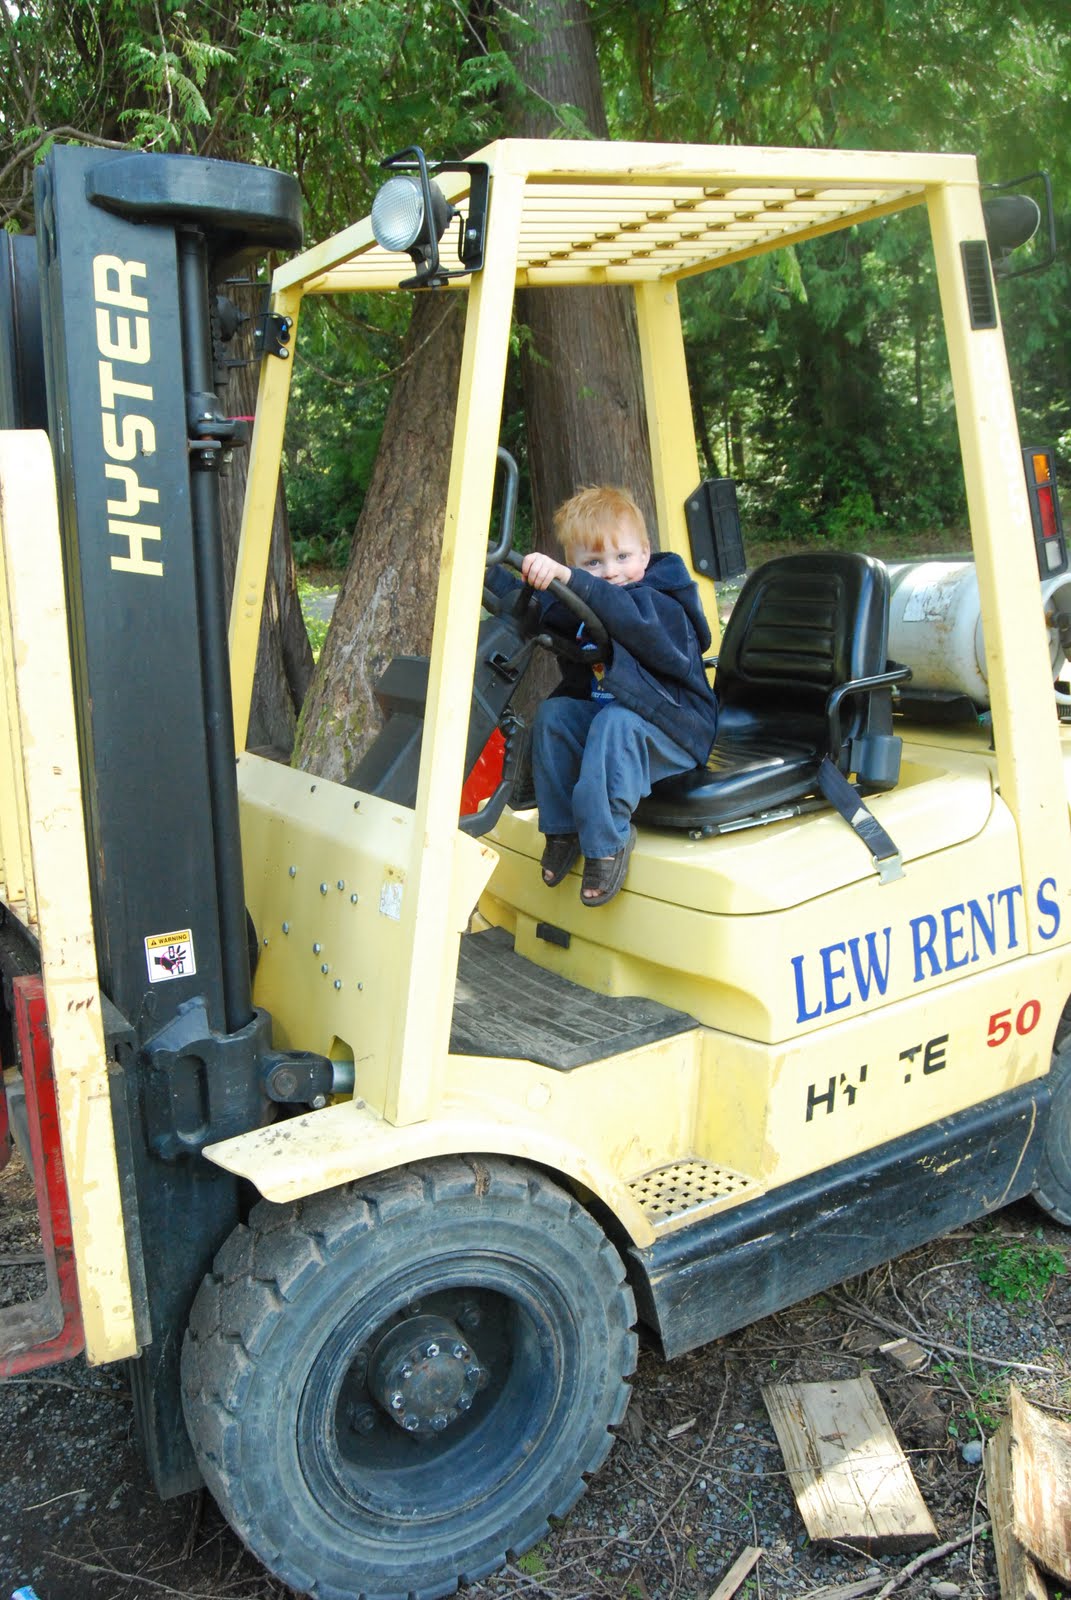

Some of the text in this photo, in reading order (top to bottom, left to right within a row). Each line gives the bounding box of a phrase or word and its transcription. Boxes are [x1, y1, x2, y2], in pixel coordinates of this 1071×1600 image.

[93, 254, 163, 577] HYSTER
[158, 934, 187, 944] WARNING
[791, 927, 892, 1024] LEW
[987, 999, 1041, 1048] 50
